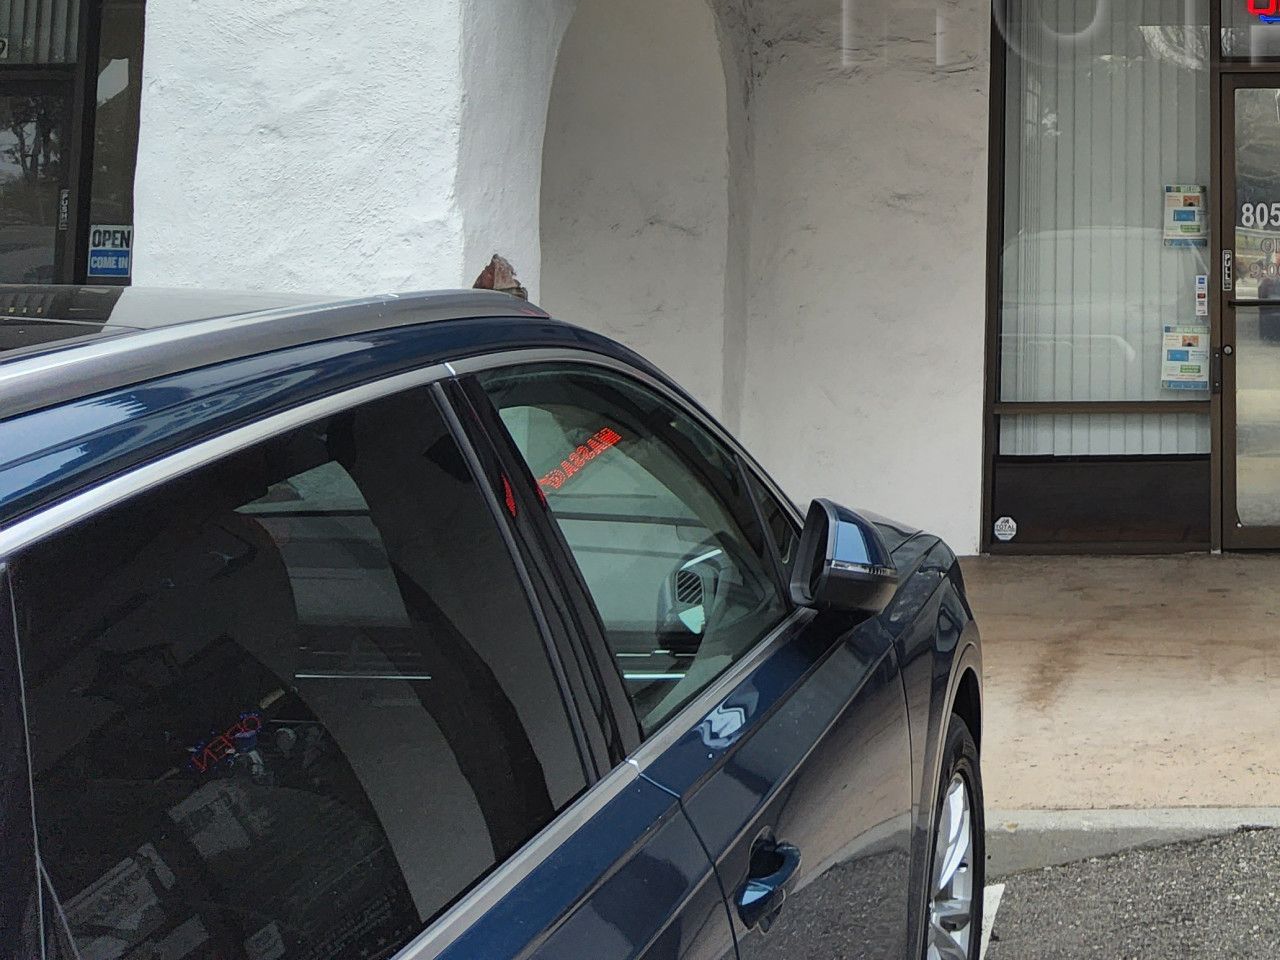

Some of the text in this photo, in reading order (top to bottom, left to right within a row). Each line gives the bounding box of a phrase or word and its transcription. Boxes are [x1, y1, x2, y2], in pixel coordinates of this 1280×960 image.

[92, 229, 131, 248] OPEN
[91, 256, 129, 269] COME IN
